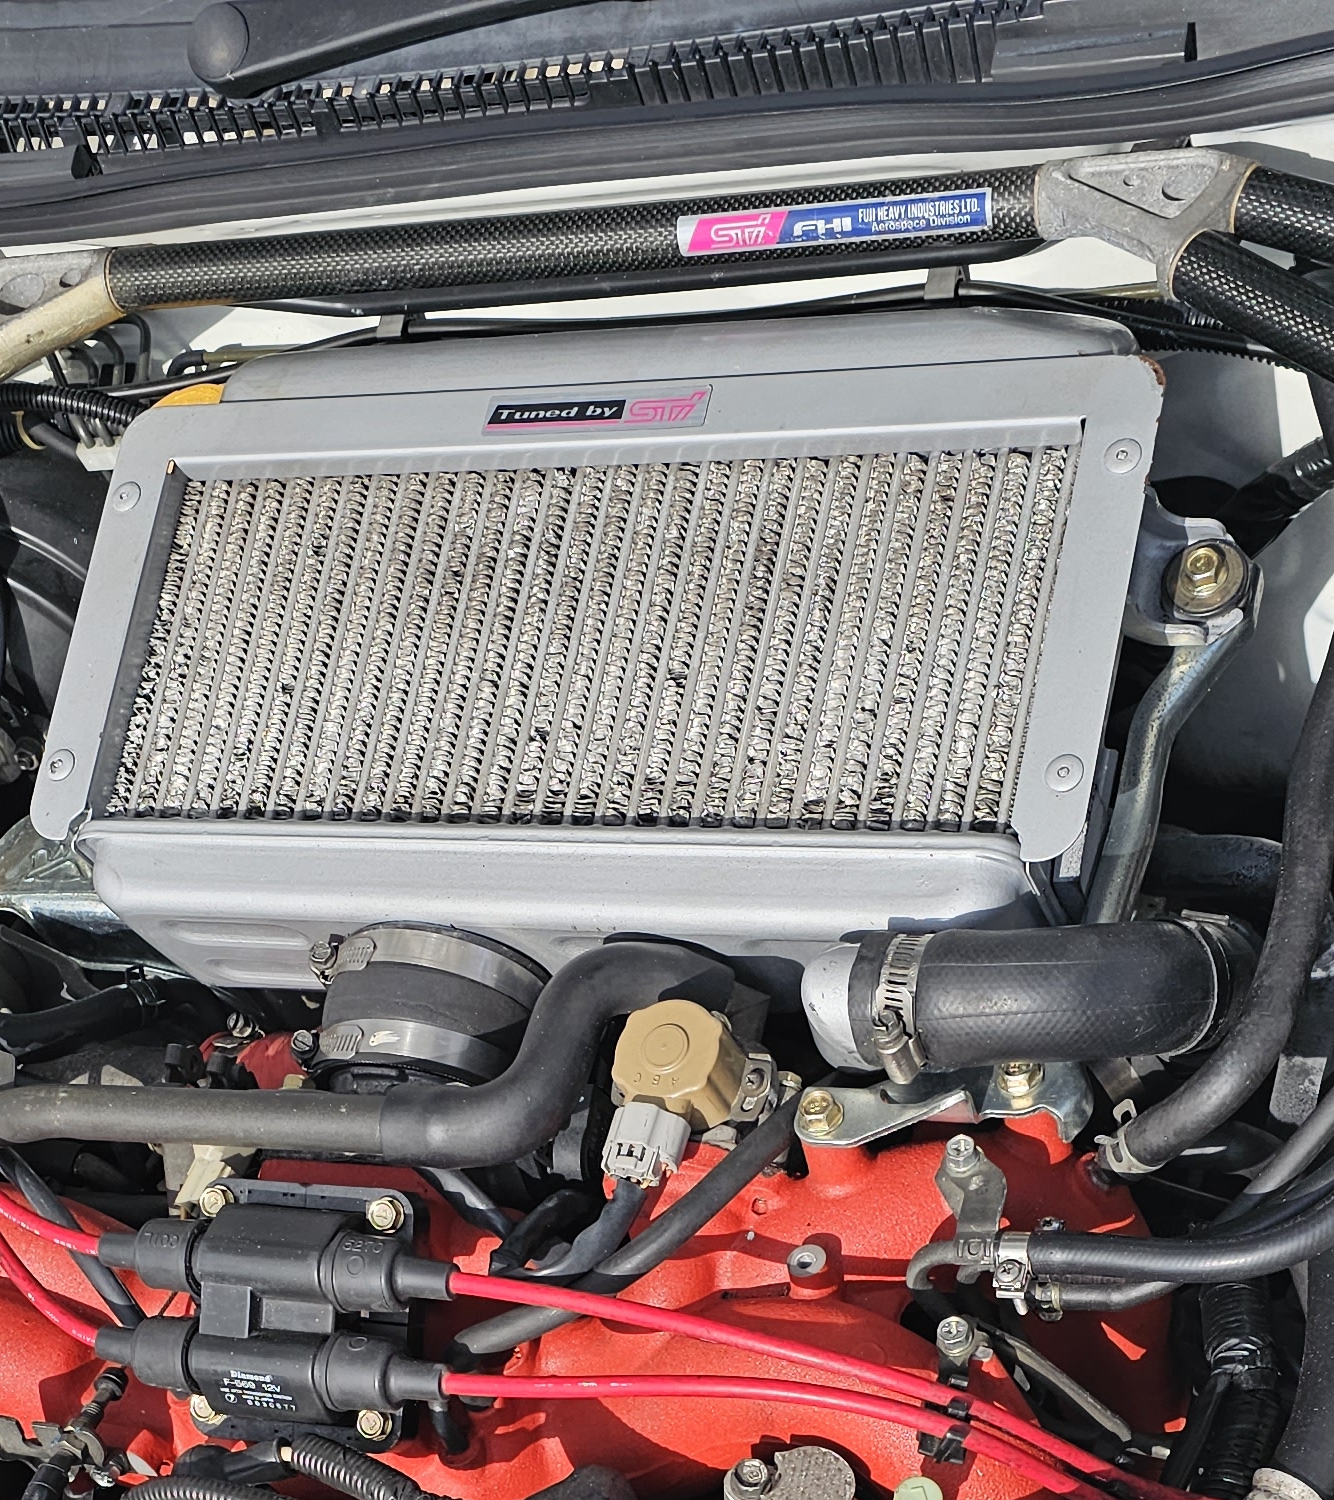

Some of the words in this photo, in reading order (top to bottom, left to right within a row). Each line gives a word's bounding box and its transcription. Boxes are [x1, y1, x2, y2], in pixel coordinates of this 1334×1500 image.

[858, 207, 875, 222] FUJI
[877, 205, 905, 220] HEAVY
[907, 199, 960, 219] INDUSTRIES
[961, 197, 980, 212] LTD.
[792, 216, 852, 236] FHI
[871, 217, 925, 234] Aerospace
[929, 212, 970, 227] Division
[497, 405, 579, 420] Tuned
[585, 404, 619, 418] by
